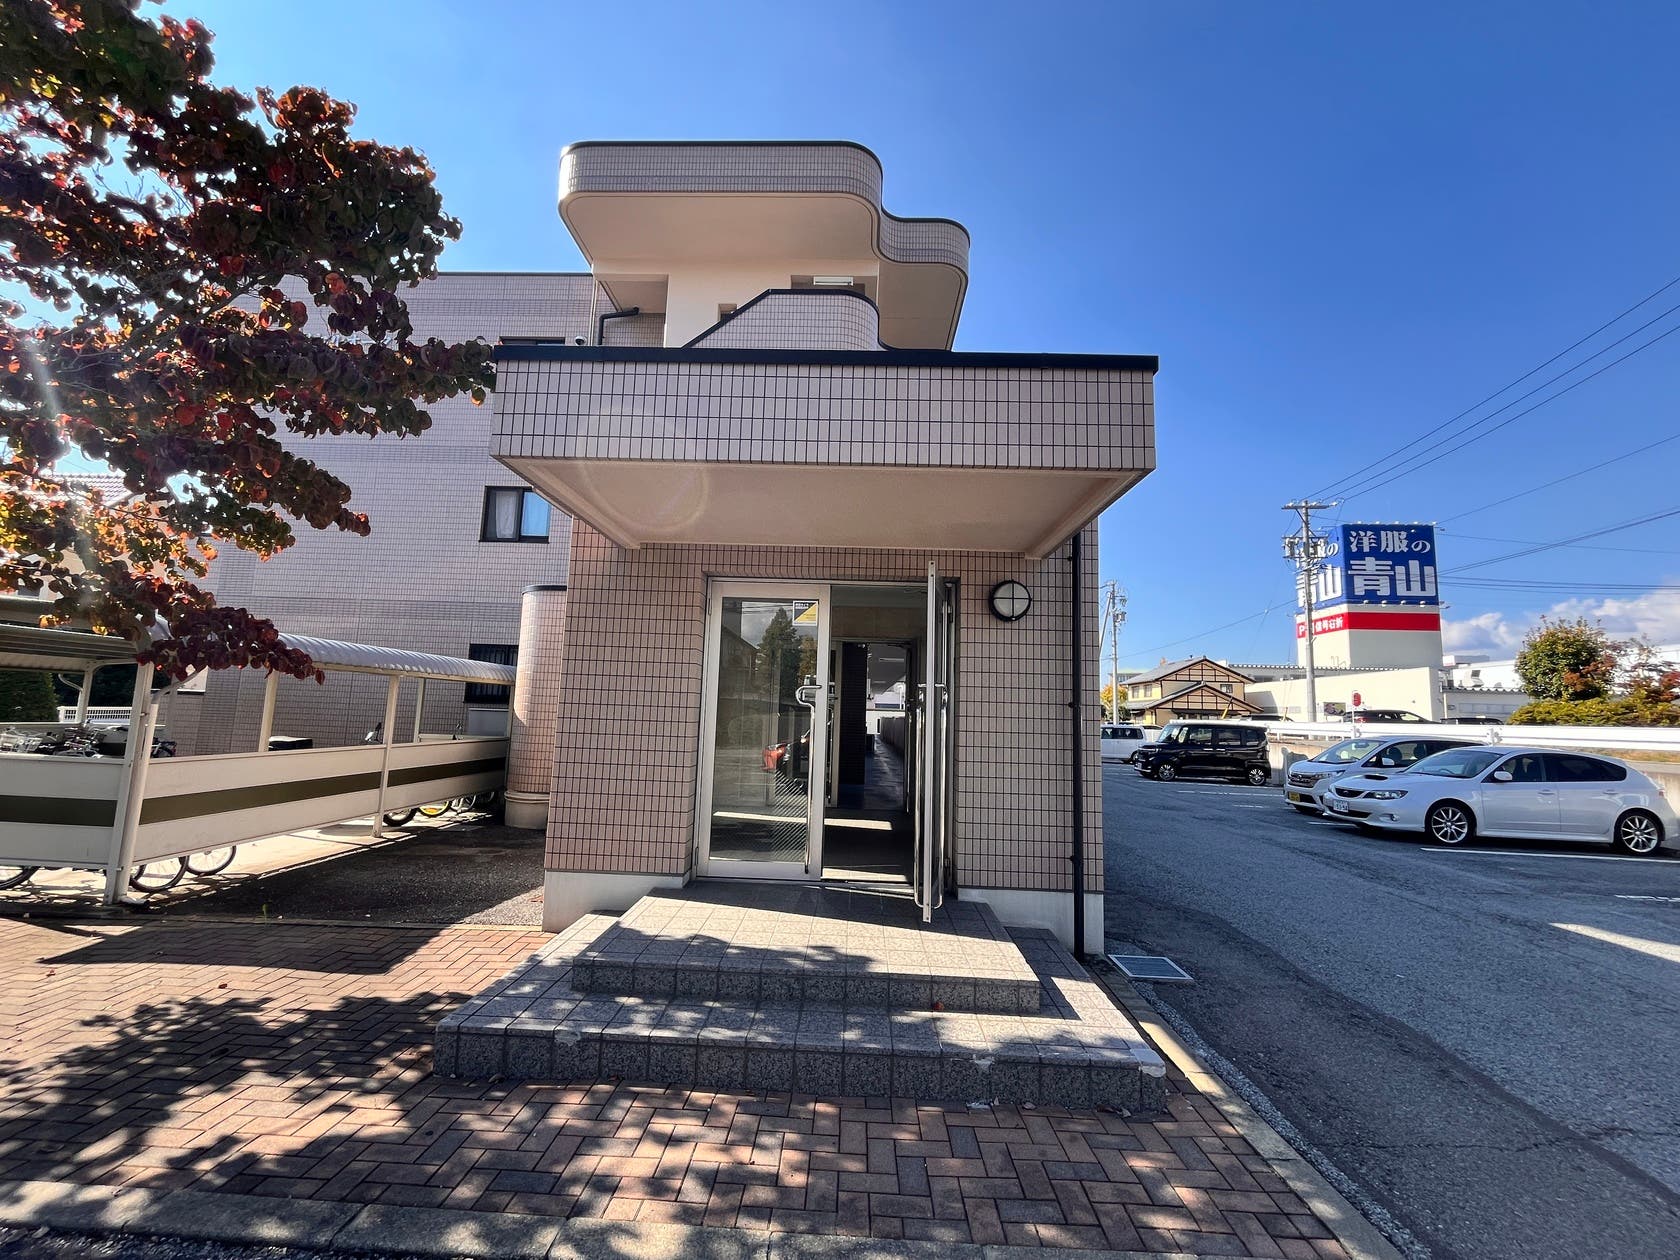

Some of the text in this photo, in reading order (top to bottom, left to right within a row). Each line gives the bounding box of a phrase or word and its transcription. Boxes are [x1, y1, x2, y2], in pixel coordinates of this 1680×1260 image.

[1349, 530, 1431, 553] 洋服の
[1348, 556, 1436, 597] 青山
